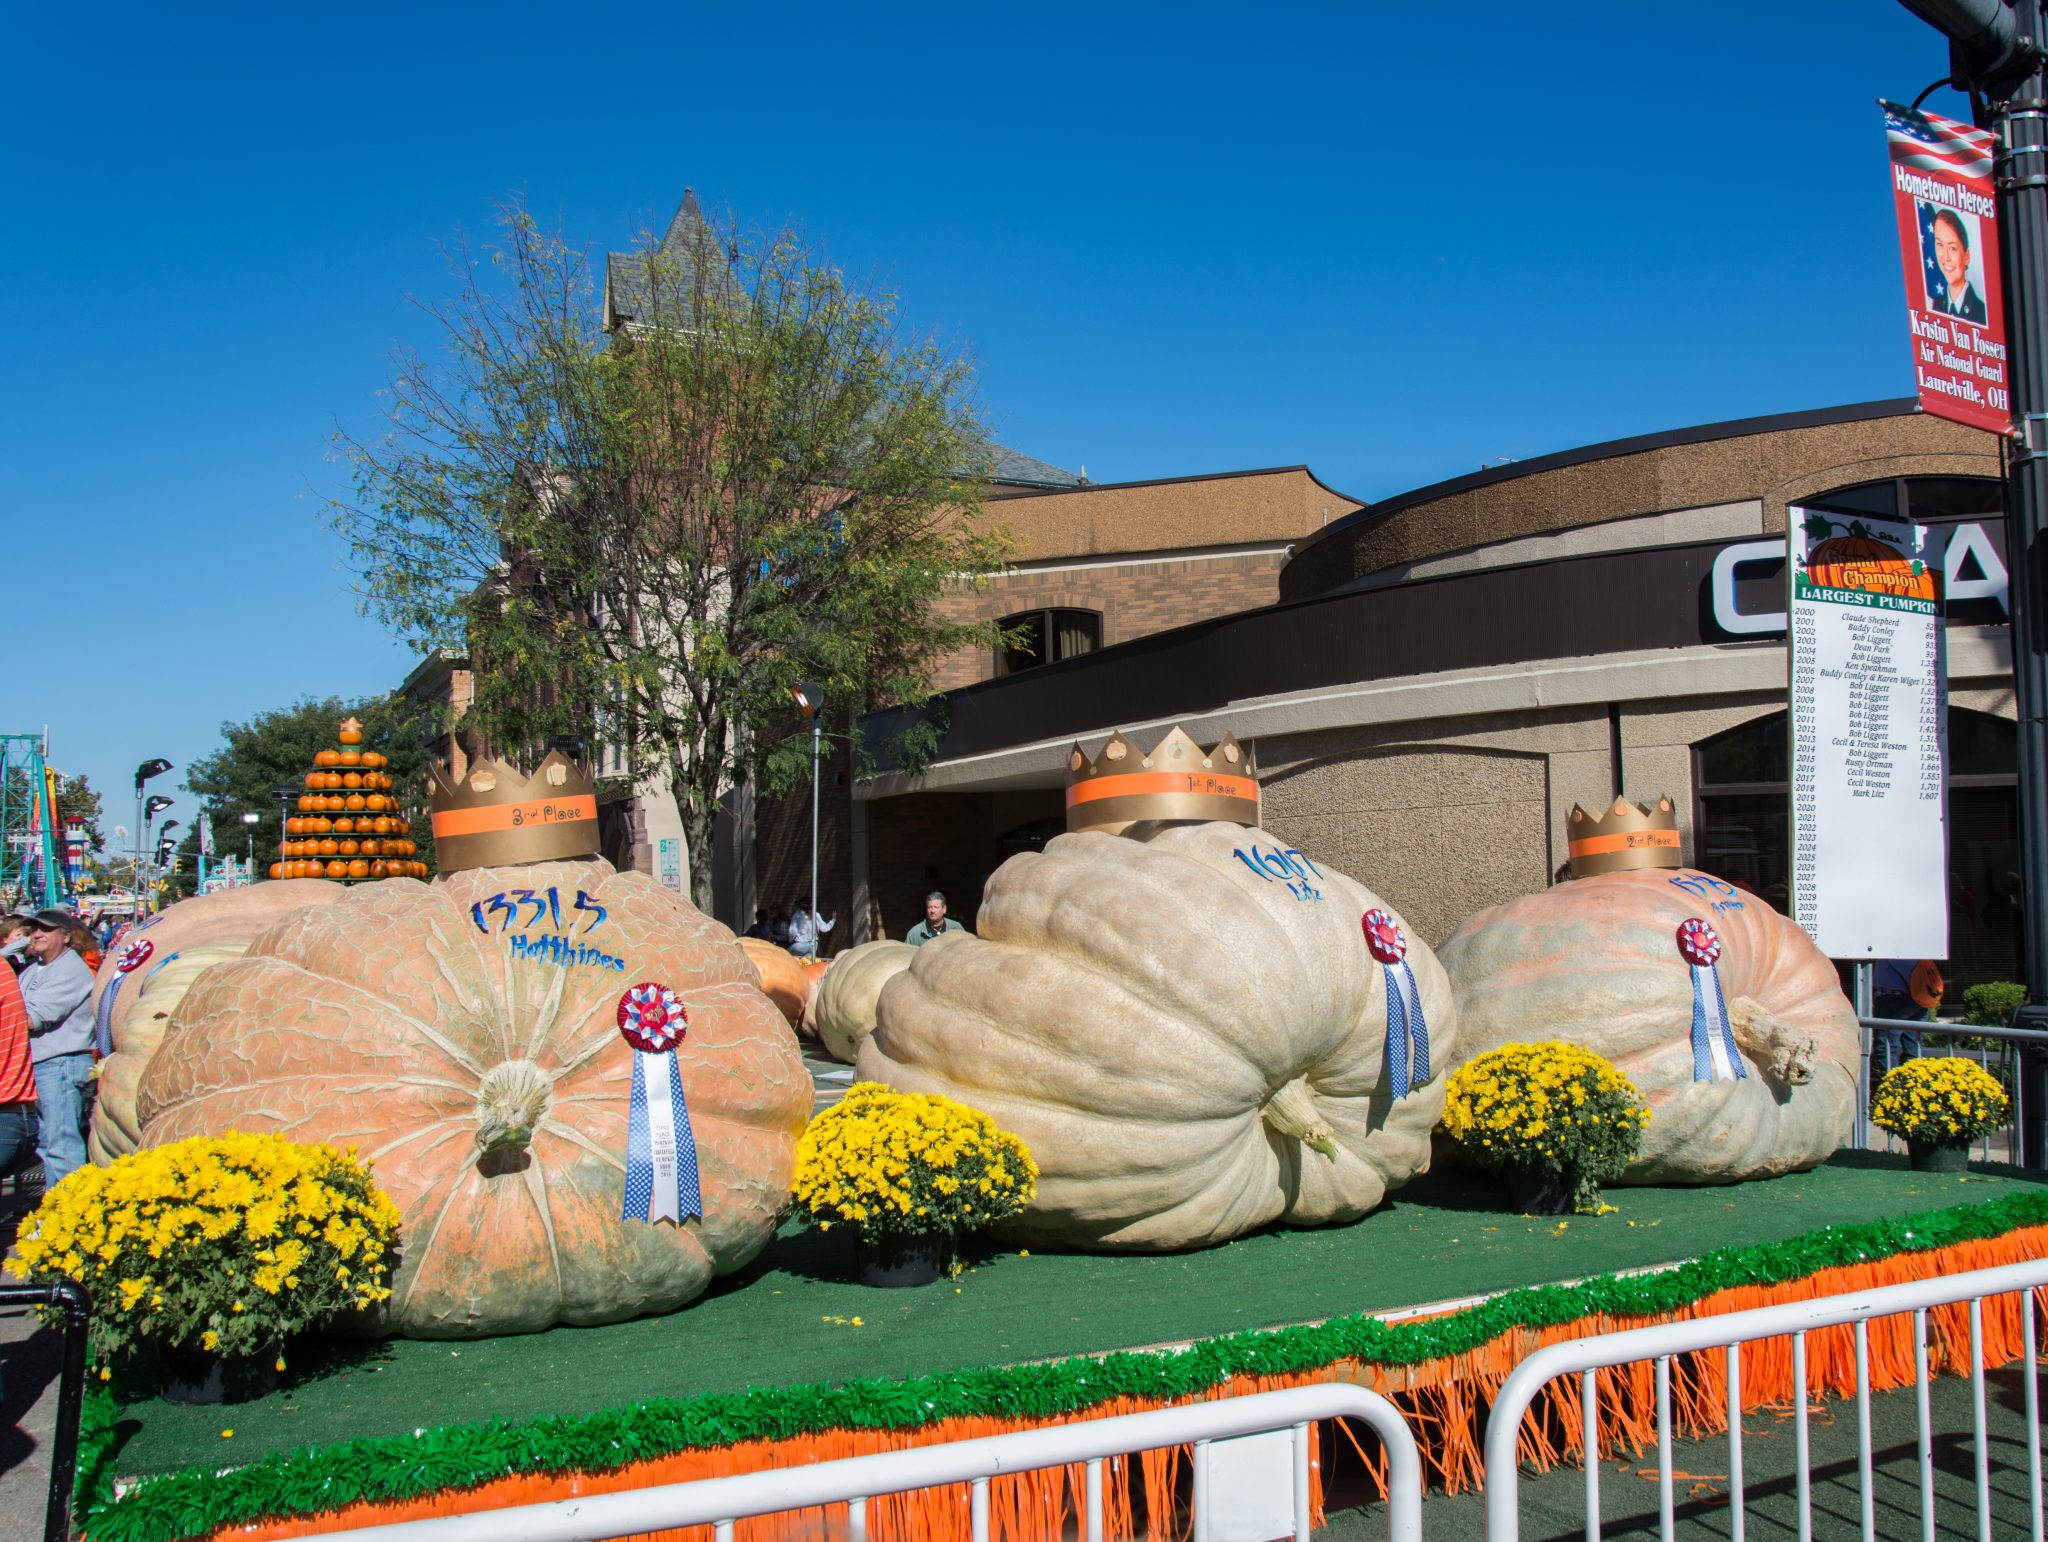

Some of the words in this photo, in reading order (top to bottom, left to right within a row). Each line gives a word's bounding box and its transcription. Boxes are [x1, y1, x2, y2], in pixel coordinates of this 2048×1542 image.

[1895, 165, 1957, 208] Hometown
[1957, 183, 1994, 218] Heroes
[1909, 309, 1950, 344] Kristin
[1951, 322, 1970, 351] Van
[1972, 327, 2006, 361] Fossen
[1921, 340, 1935, 363] Air
[1937, 347, 1973, 375] National
[1976, 357, 2003, 383] Guard
[1918, 366, 1985, 409] Laurelville,
[1988, 387, 2008, 411] OH
[1824, 549, 1876, 568] Grand
[1843, 570, 1919, 589] Champion
[1801, 587, 1874, 606] LARGEST
[1880, 596, 1939, 614] PUMPKIN
[1795, 608, 1815, 616] 2000
[1841, 613, 1866, 622] Claude
[1868, 616, 1899, 627] Shepherd
[1795, 617, 1814, 625] 2001
[1848, 624, 1870, 634] Buddy
[1872, 626, 1894, 637] Conley
[1796, 627, 1816, 635] 2002
[1867, 635, 1891, 645] Liggett
[1797, 637, 1816, 645] 2003
[1854, 643, 1871, 651] Dean
[1797, 646, 1816, 655] 2004
[1867, 654, 1891, 664] Liggett
[1797, 656, 1816, 664] 2005
[1845, 662, 1858, 670] Ken
[1796, 666, 1815, 674] 2006
[1820, 669, 1842, 680] Buddy
[1844, 671, 1867, 682] Conley
[1877, 674, 1898, 683] Karen
[1796, 676, 1815, 684] 2007
[1865, 683, 1889, 693] Liggett
[1796, 686, 1814, 694] 2008
[1864, 693, 1889, 703] Liggett
[1796, 705, 1815, 713] 2010
[1863, 712, 1889, 722] Liggett
[1863, 702, 1889, 712] Liggett
[1796, 715, 1814, 723] 2011
[1863, 721, 1889, 731] Liggett
[1797, 725, 1816, 733] 2012
[1863, 731, 1889, 741] Liggett
[1797, 735, 1816, 743] 2013
[1831, 738, 1848, 746] Cecil
[1857, 740, 1879, 748] Teresa
[1881, 742, 1907, 750] Weston
[1796, 754, 1815, 762] 2015
[1845, 759, 1865, 768] Rusty
[1863, 750, 1889, 760] Liggett
[1796, 764, 1815, 772] 2016
[1847, 768, 1864, 776] Cecil
[1866, 769, 1890, 778] Weston
[1206, 779, 1236, 795] Place
[1796, 774, 1815, 782] 2017
[1866, 780, 1890, 788] Weston
[1796, 784, 1815, 792] 2018
[512, 808, 538, 826] 3rd
[543, 805, 582, 823] Place
[1647, 834, 1671, 846] Place
[1233, 845, 1323, 882] 1607
[471, 886, 608, 934] 1331.5
